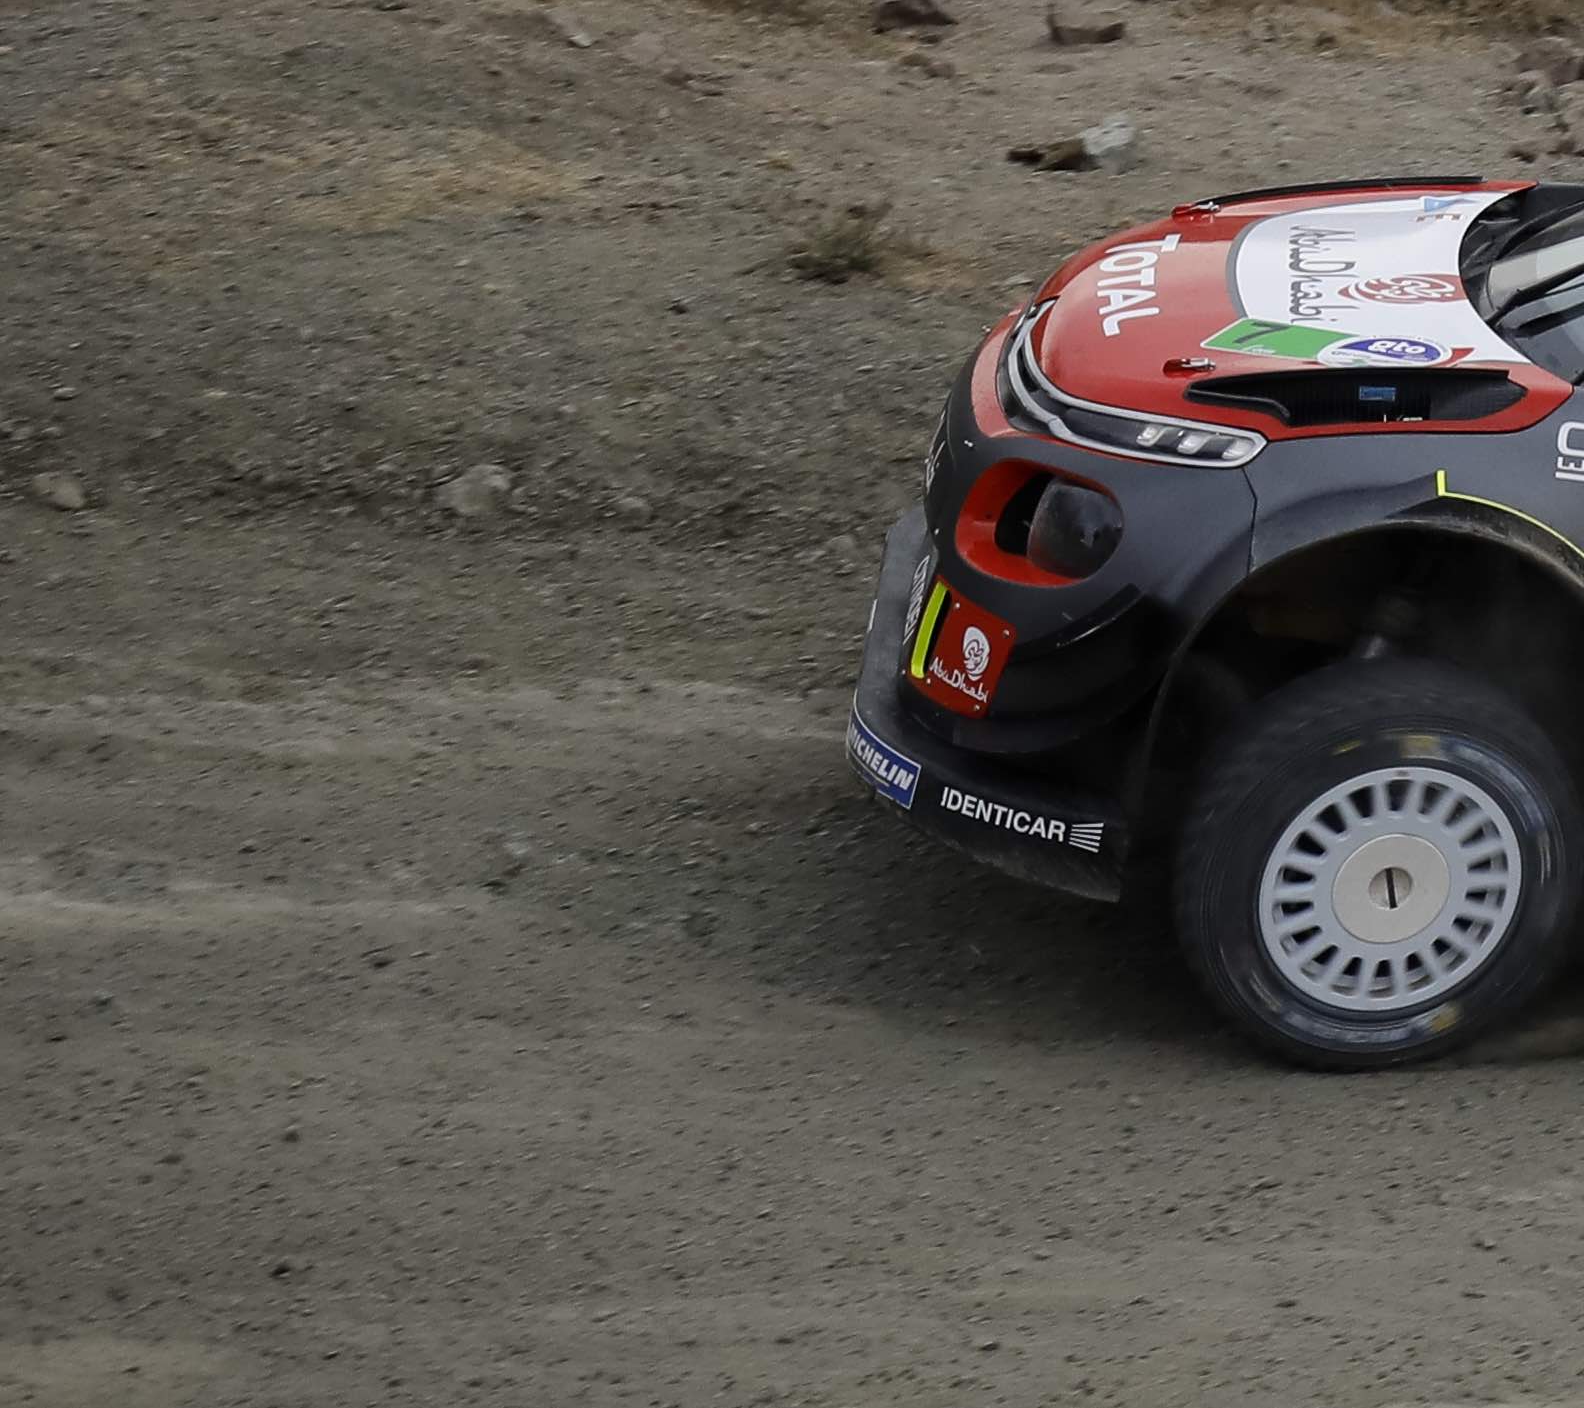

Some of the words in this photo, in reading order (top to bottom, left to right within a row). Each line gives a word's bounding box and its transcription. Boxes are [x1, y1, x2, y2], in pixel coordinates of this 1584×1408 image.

[1097, 232, 1183, 337] TOTAL
[1232, 319, 1291, 345] 7
[940, 785, 1066, 843] IDENTICAR
